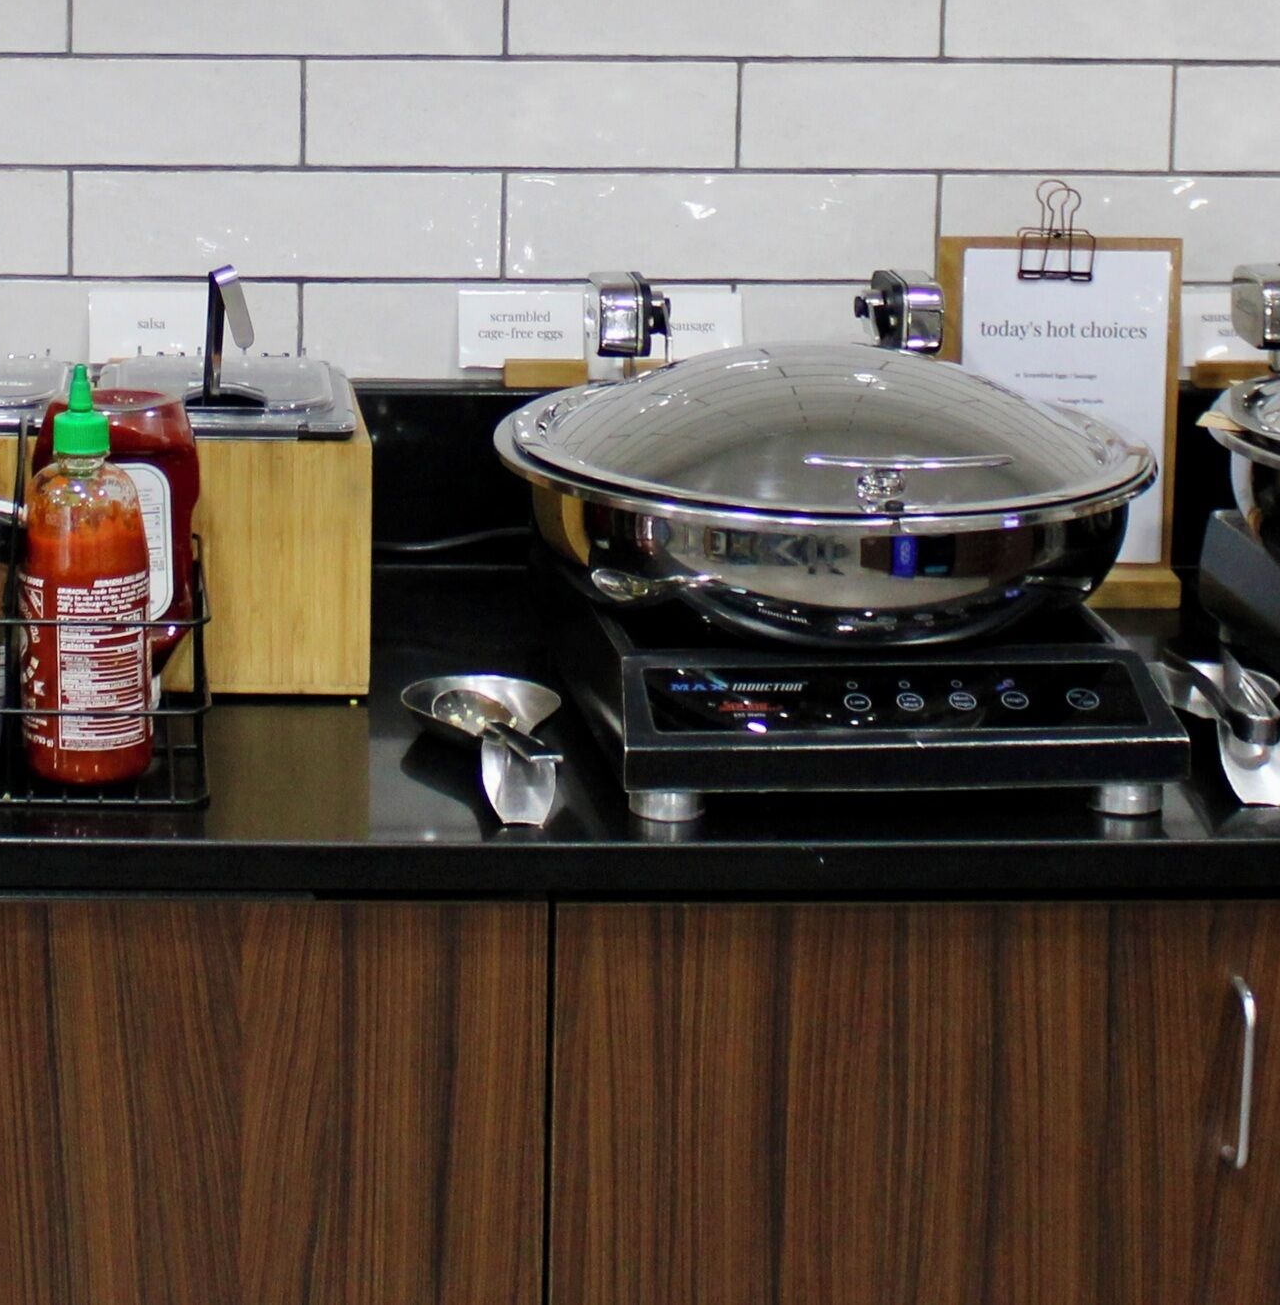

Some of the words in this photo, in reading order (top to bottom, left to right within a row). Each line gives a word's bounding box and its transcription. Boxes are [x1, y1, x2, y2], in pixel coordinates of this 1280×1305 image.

[137, 317, 166, 330] salsa
[490, 310, 551, 324] scrambled
[478, 326, 534, 341] cage-free
[537, 328, 564, 341] eggs
[980, 320, 1043, 341] today's
[1046, 320, 1076, 339] hot
[1080, 321, 1148, 340] choices
[671, 682, 729, 692] MAX
